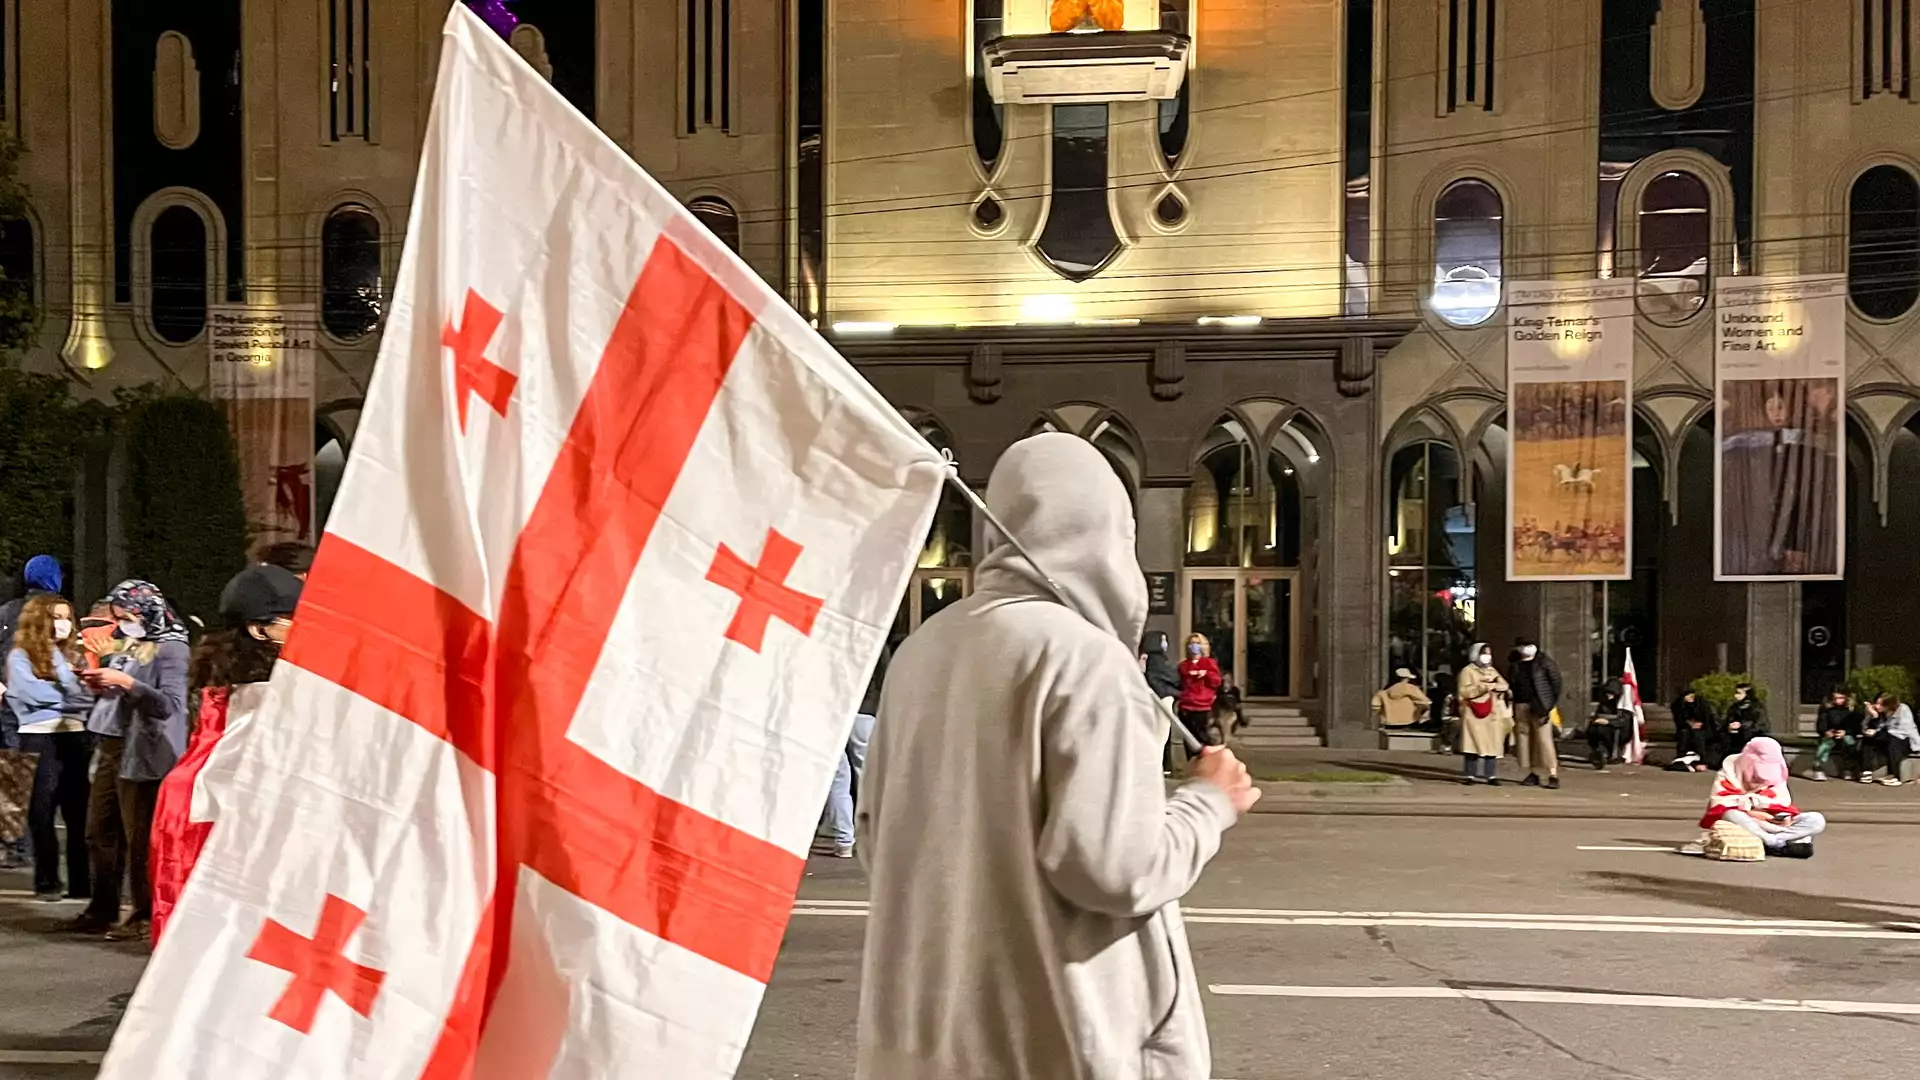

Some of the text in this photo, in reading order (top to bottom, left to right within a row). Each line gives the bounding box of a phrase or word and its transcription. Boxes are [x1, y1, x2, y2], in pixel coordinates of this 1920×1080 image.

[1514, 316, 1544, 329] King
[1722, 312, 1783, 323] Unbound
[1514, 329, 1602, 342] Golden Reign
[1722, 325, 1803, 337] Women and
[1722, 340, 1776, 351] Fine Art
[226, 352, 272, 364] Georgia
